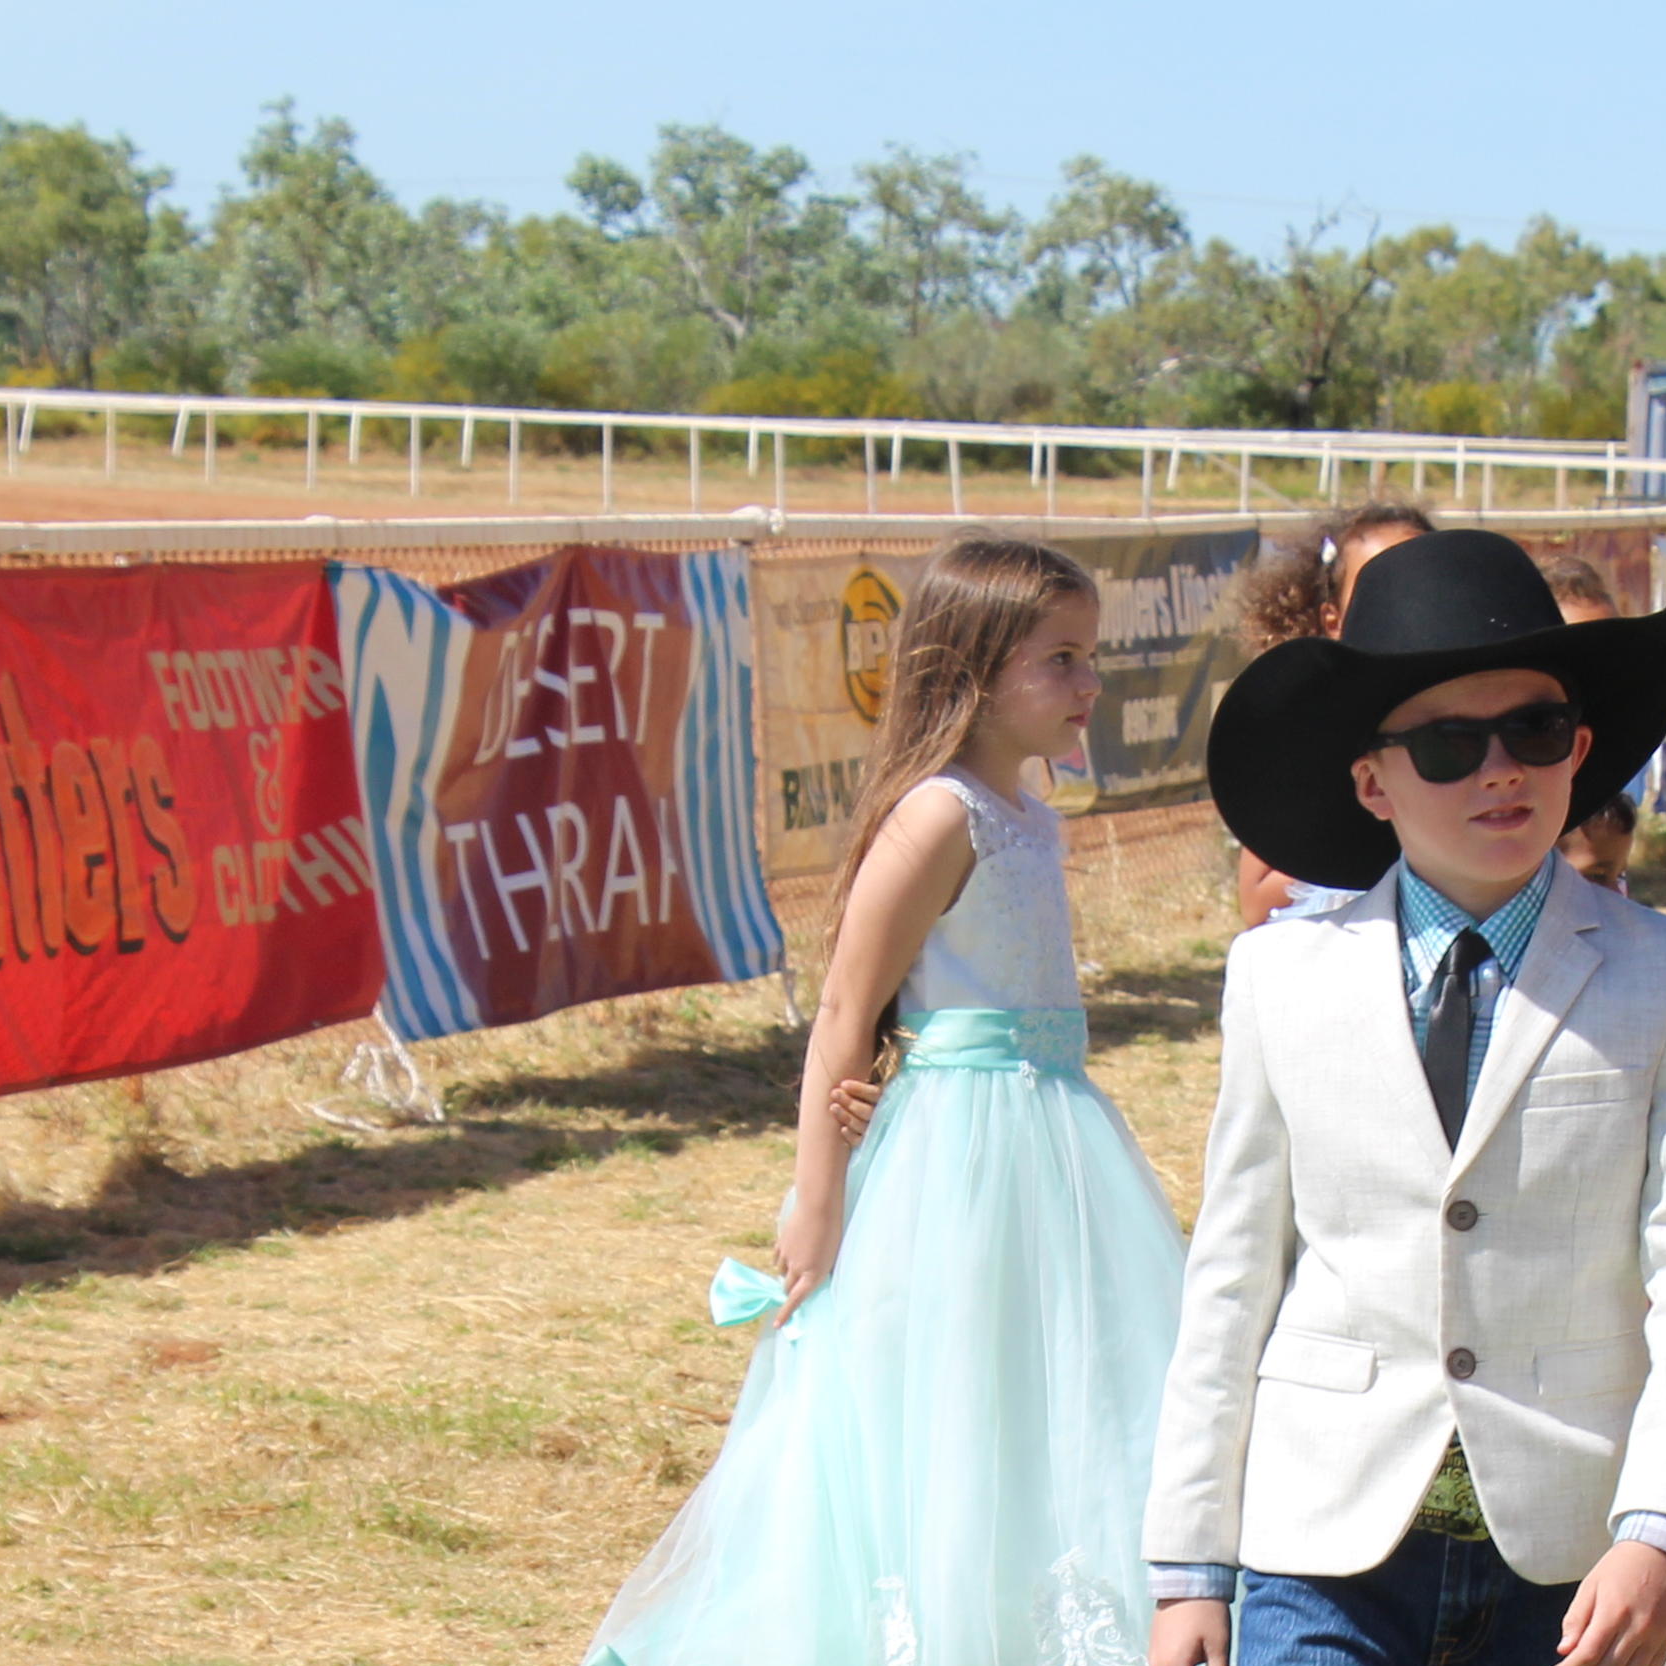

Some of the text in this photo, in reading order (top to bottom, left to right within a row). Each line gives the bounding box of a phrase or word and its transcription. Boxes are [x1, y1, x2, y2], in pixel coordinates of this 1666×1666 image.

[148, 645, 346, 731] FOOTWEAR
[472, 606, 666, 767] DESERT
[247, 725, 284, 836] &
